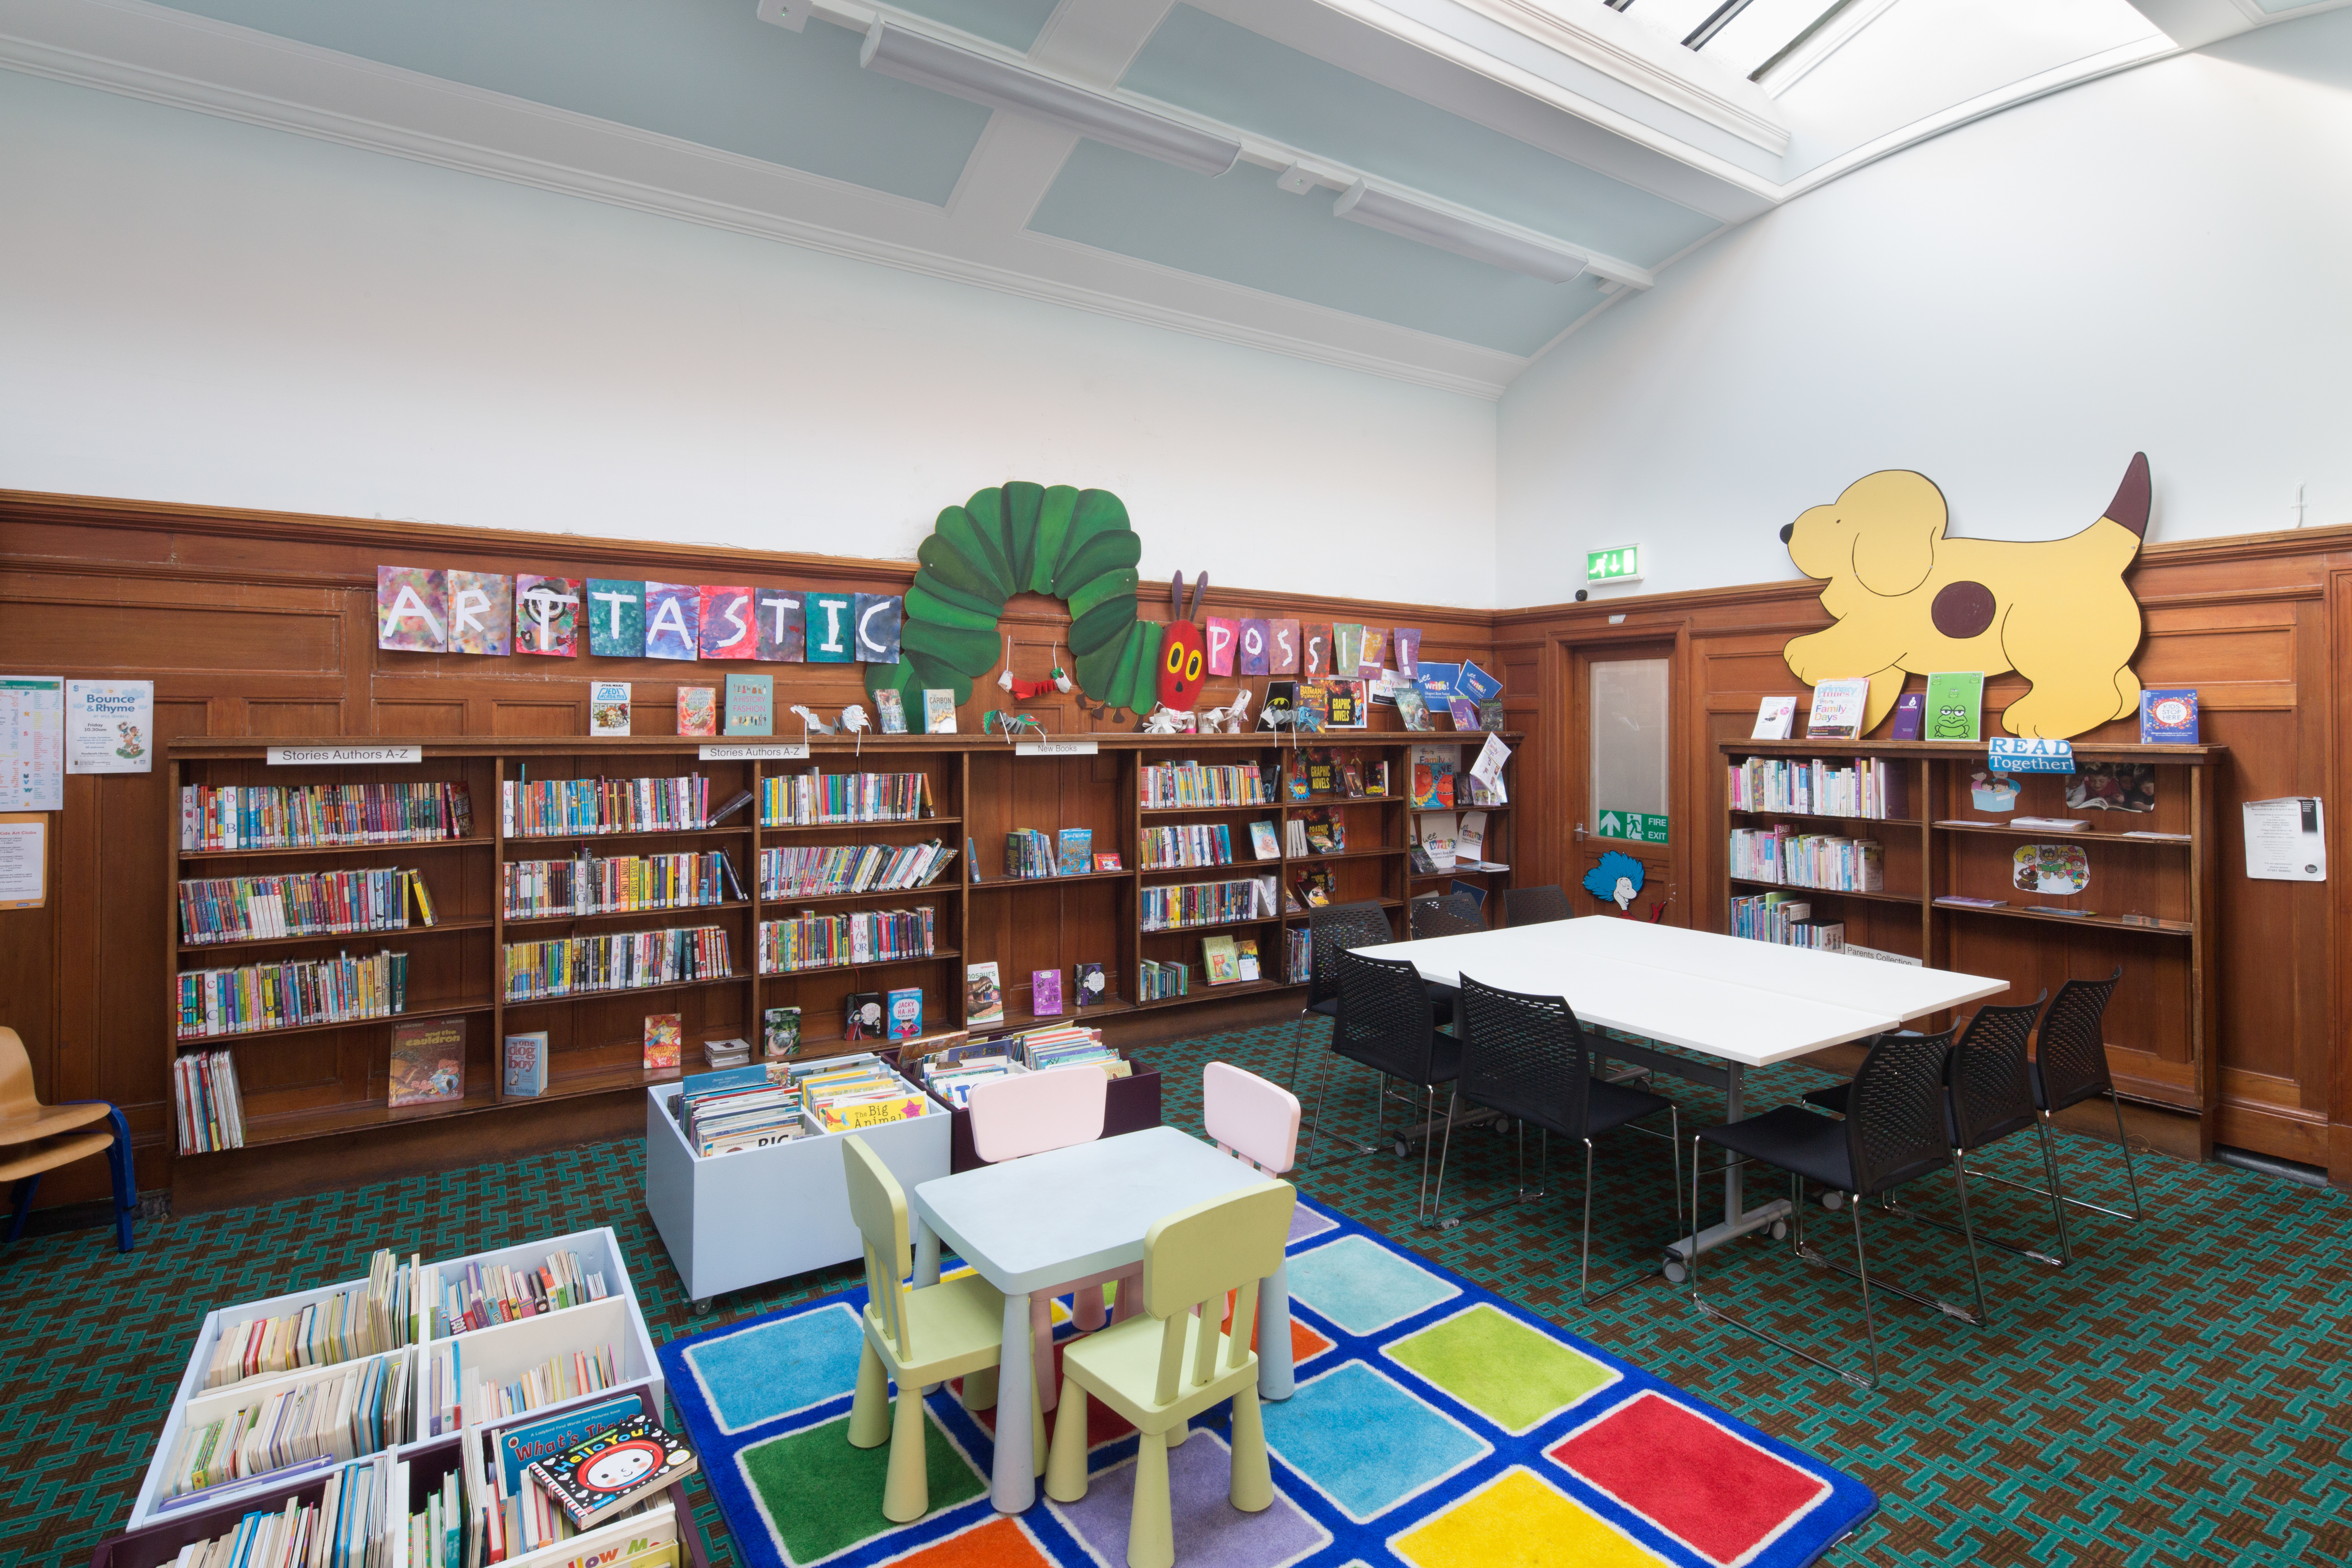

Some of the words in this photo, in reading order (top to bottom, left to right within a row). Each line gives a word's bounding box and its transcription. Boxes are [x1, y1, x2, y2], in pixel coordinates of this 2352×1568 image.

[1418, 674, 1431, 684] wee
[1300, 685, 1322, 695] BATMAN
[1376, 684, 1390, 693] Days
[1425, 681, 1449, 690] write!
[1470, 679, 1486, 694] write!
[1818, 686, 1858, 695] primary
[87, 695, 135, 703] Bounce
[1332, 698, 1351, 710] GRAPHIC
[96, 704, 135, 713] Rhyme
[1816, 705, 1846, 714] Family
[1333, 710, 1350, 721] NOVELS
[1815, 713, 1838, 722] Days
[1991, 738, 2072, 756] READ
[283, 750, 329, 761] Stories
[333, 749, 382, 760] Authors
[385, 749, 408, 759] A-Z
[710, 747, 744, 758] Stories
[746, 748, 782, 757] Authors
[783, 747, 800, 755] A-Z
[1990, 756, 2074, 772] Together!
[1311, 766, 1330, 777] GRAPHIC
[1434, 764, 1452, 782] DAVE
[681, 780, 686, 790] f
[1312, 777, 1330, 789] NOVELS
[504, 785, 512, 795] d
[226, 791, 235, 802] b
[642, 810, 650, 819] E
[682, 808, 688, 816] F
[503, 815, 513, 824] D
[1648, 818, 1666, 826] FIRE
[225, 823, 236, 833] B
[1779, 825, 1790, 833] BABY
[1423, 832, 1437, 843] wee
[1463, 830, 1482, 840] write!
[1648, 831, 1666, 840] EXIT
[1430, 839, 1457, 850] write!
[681, 858, 687, 867] h
[1071, 860, 1080, 873] 2
[577, 868, 584, 878] g
[681, 884, 688, 893] H
[577, 893, 585, 902] G
[1206, 940, 1232, 948] READ
[1207, 948, 1233, 958] HEAR
[1847, 947, 1874, 959] Parents
[1876, 953, 1912, 965] Collection
[967, 970, 996, 979] nosaurs
[207, 980, 216, 989] c
[863, 1004, 879, 1013] Goth
[207, 1009, 218, 1020] C
[864, 1010, 878, 1018] Girl
[405, 1035, 460, 1046] cauldron
[508, 1042, 535, 1060] dog
[508, 1056, 535, 1072] boy
[868, 1105, 888, 1116] Big
[855, 1114, 901, 1129] Animal
[535, 1427, 555, 1436] Ladybird
[591, 1412, 609, 1421] Pictures
[515, 1430, 579, 1462] What's
[554, 1443, 606, 1472] Hello
[605, 1424, 649, 1446] You!
[594, 1497, 612, 1508] Campbell
